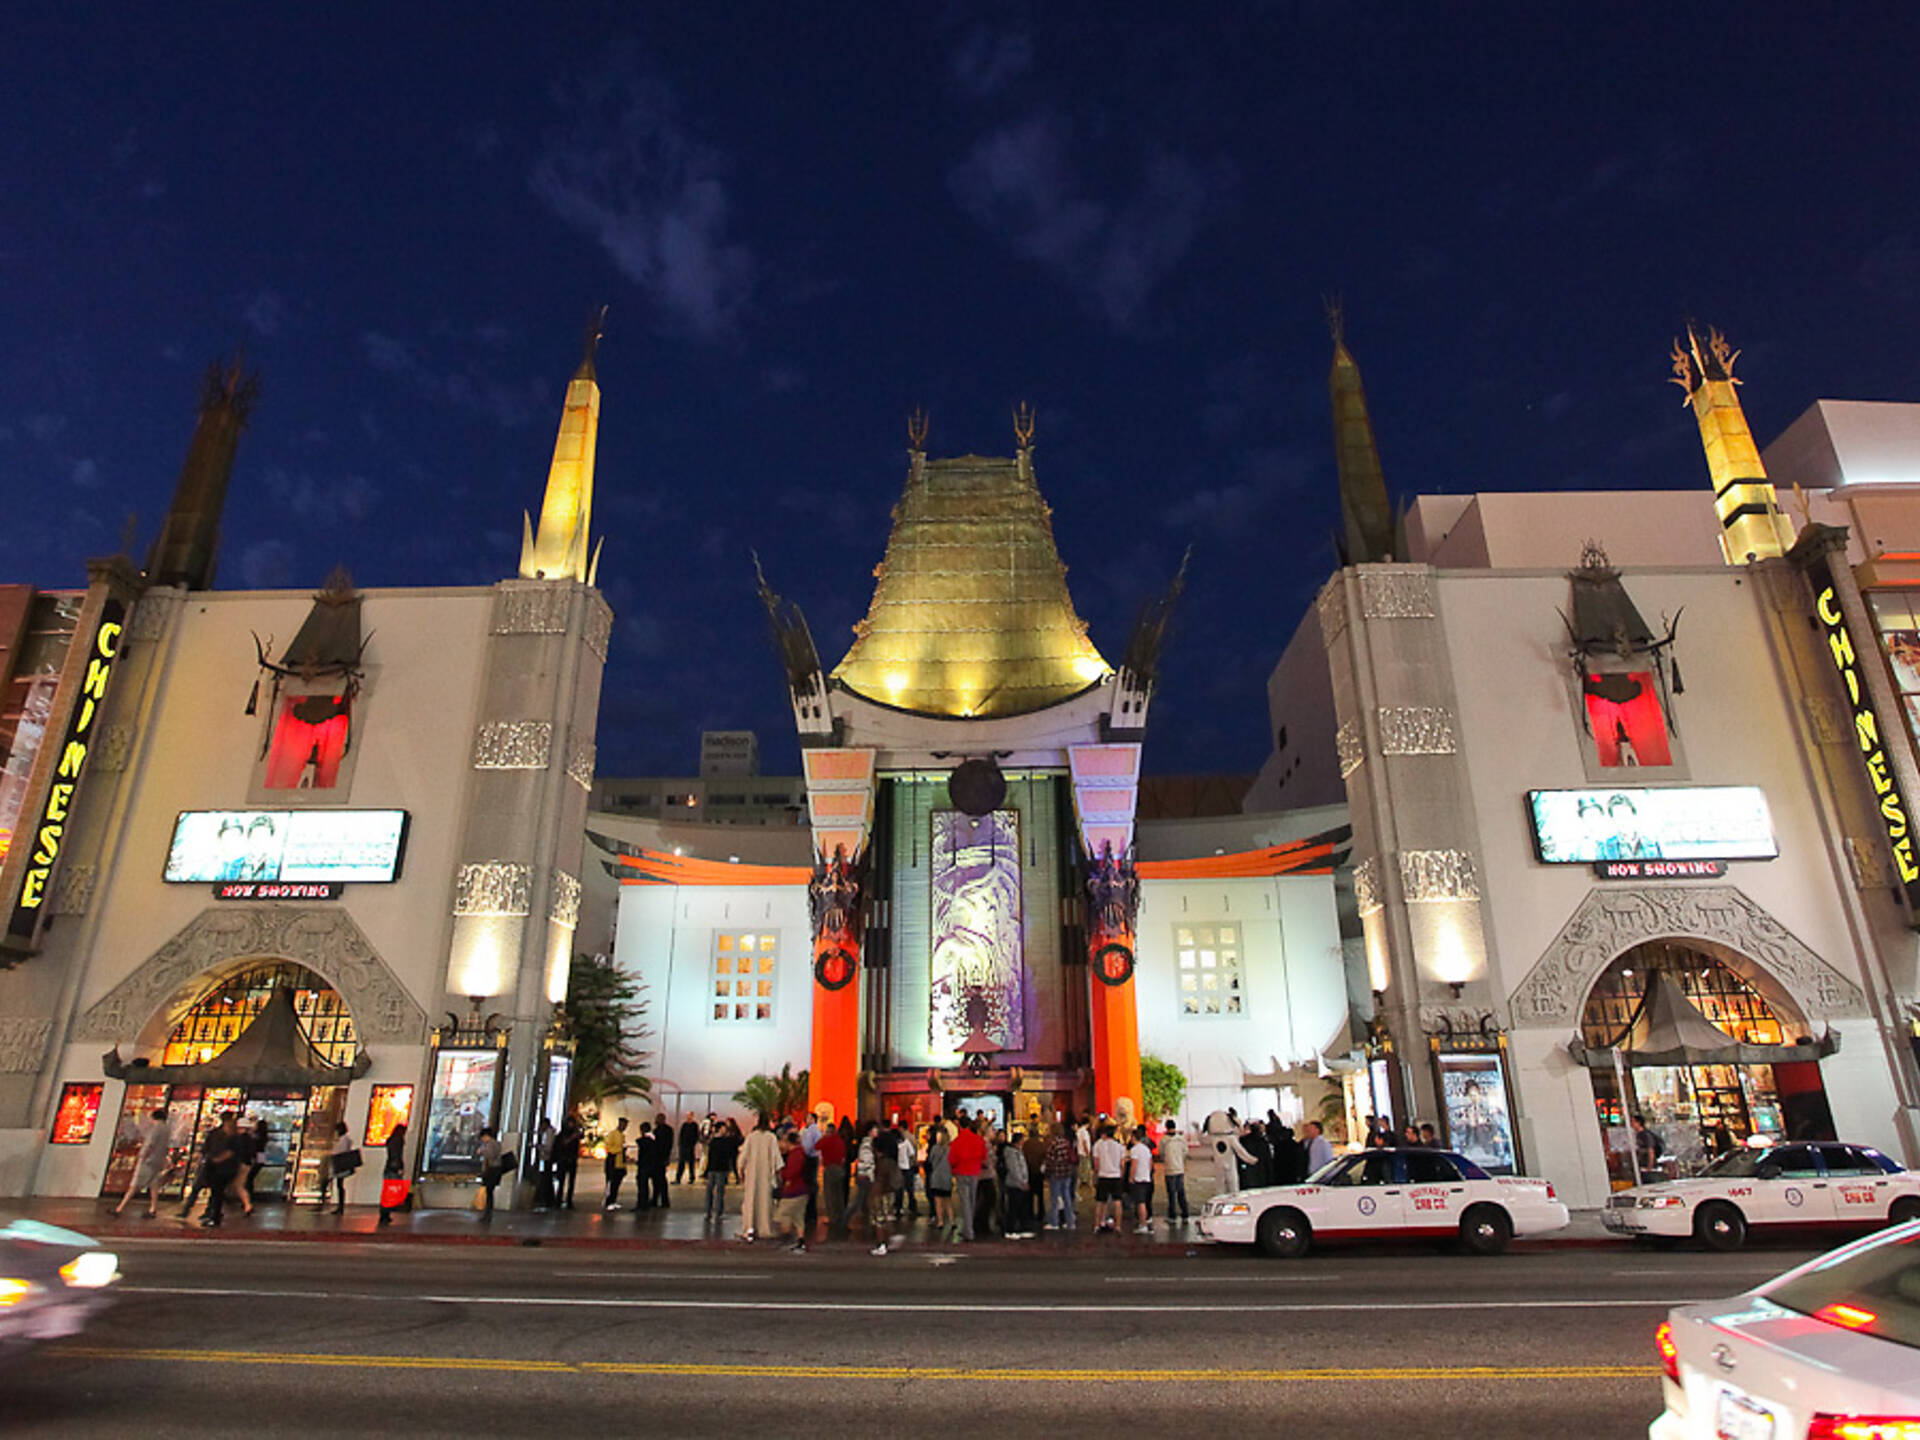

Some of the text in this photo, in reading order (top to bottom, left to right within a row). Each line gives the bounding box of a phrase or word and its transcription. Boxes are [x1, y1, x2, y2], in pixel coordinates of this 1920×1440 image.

[20, 622, 121, 908] CHINESE
[1817, 586, 1919, 884] CHINESE
[221, 884, 329, 897] NOW SHOWING
[1607, 861, 1718, 876] NOW SHOWING
